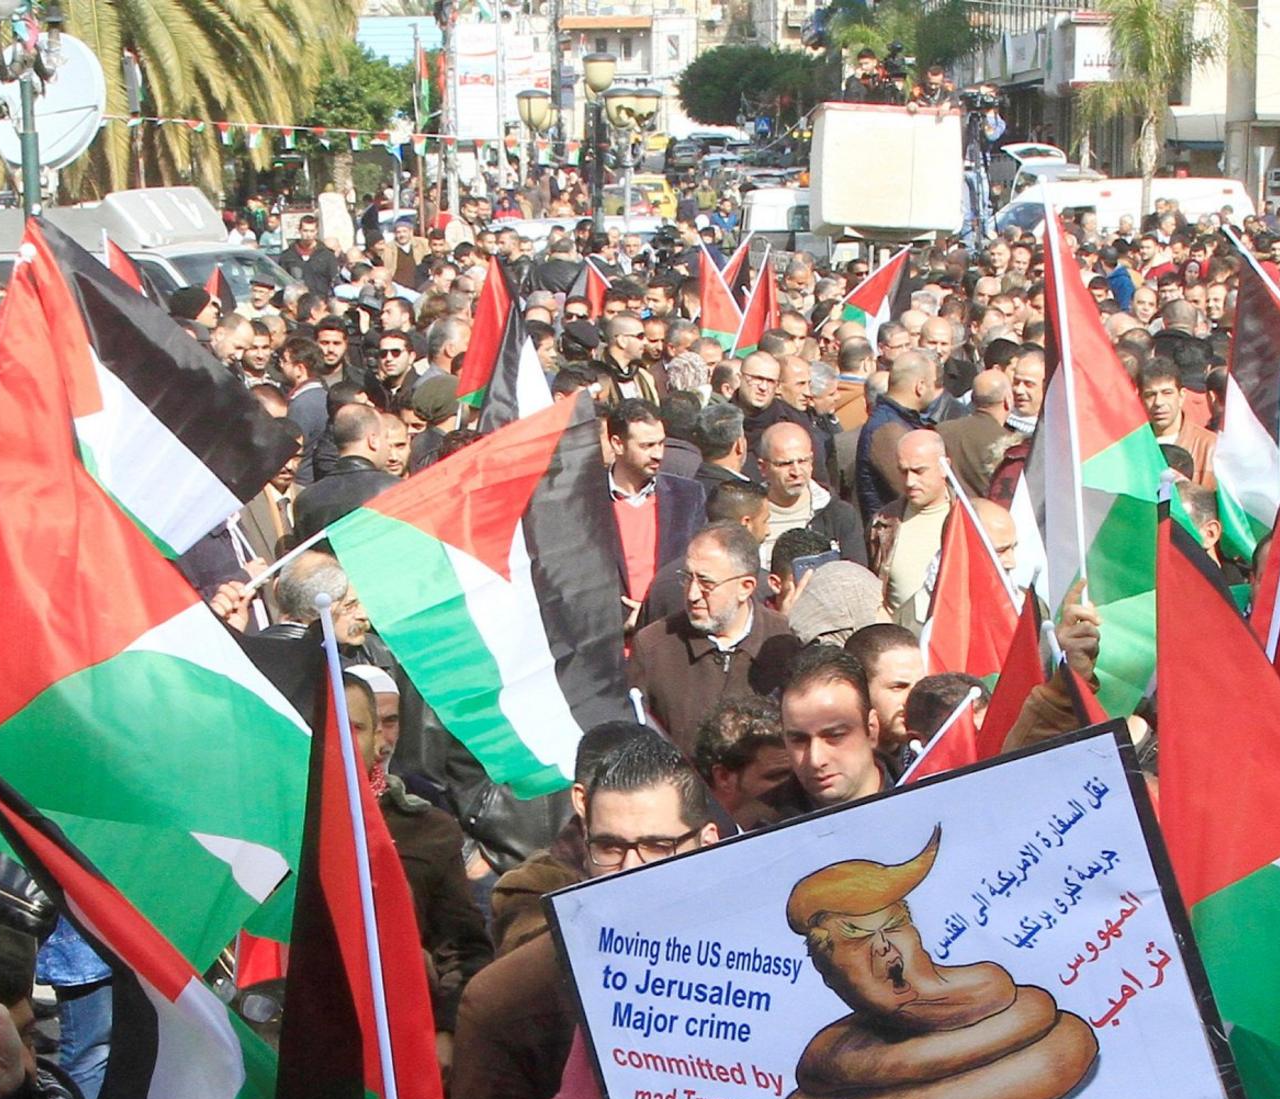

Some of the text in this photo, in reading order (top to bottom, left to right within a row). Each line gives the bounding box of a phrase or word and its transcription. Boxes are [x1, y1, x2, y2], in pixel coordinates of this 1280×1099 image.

[934, 776, 1109, 960] نقل السفارة الامريكية الى القدس
[1003, 848, 1121, 949] جريمة كبرى يرتكبها
[598, 927, 803, 985] Moving the US embassy
[1059, 890, 1144, 986] المهووس
[602, 965, 771, 1012] to Jerusalem
[1089, 941, 1173, 1029] ترامب
[612, 1001, 751, 1043] Major crime
[612, 1047, 784, 1097] committed by
